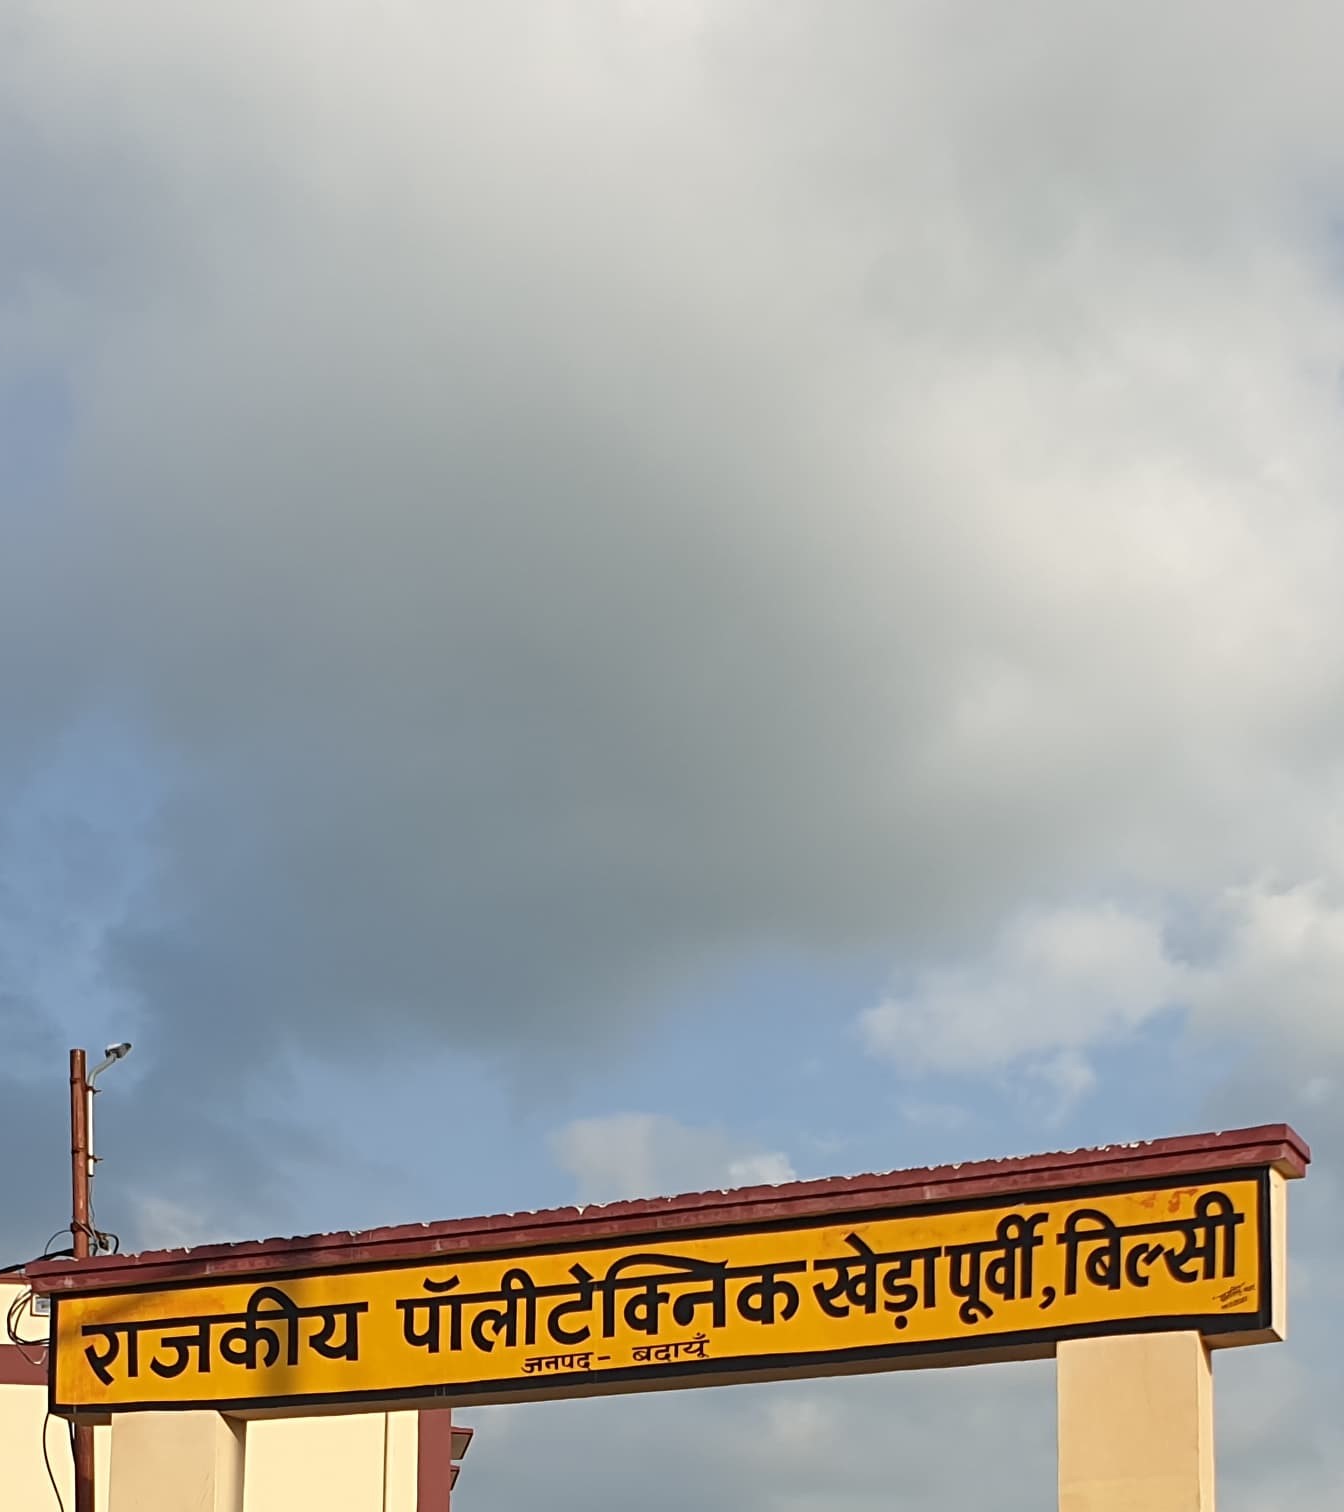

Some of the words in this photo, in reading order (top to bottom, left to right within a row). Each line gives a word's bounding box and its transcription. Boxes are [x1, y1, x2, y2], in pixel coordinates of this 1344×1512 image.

[81, 1285, 369, 1387] राजकीय
[395, 1252, 807, 1355] पॉलीटेक्निक
[1056, 1190, 1245, 1297] बिल्सी
